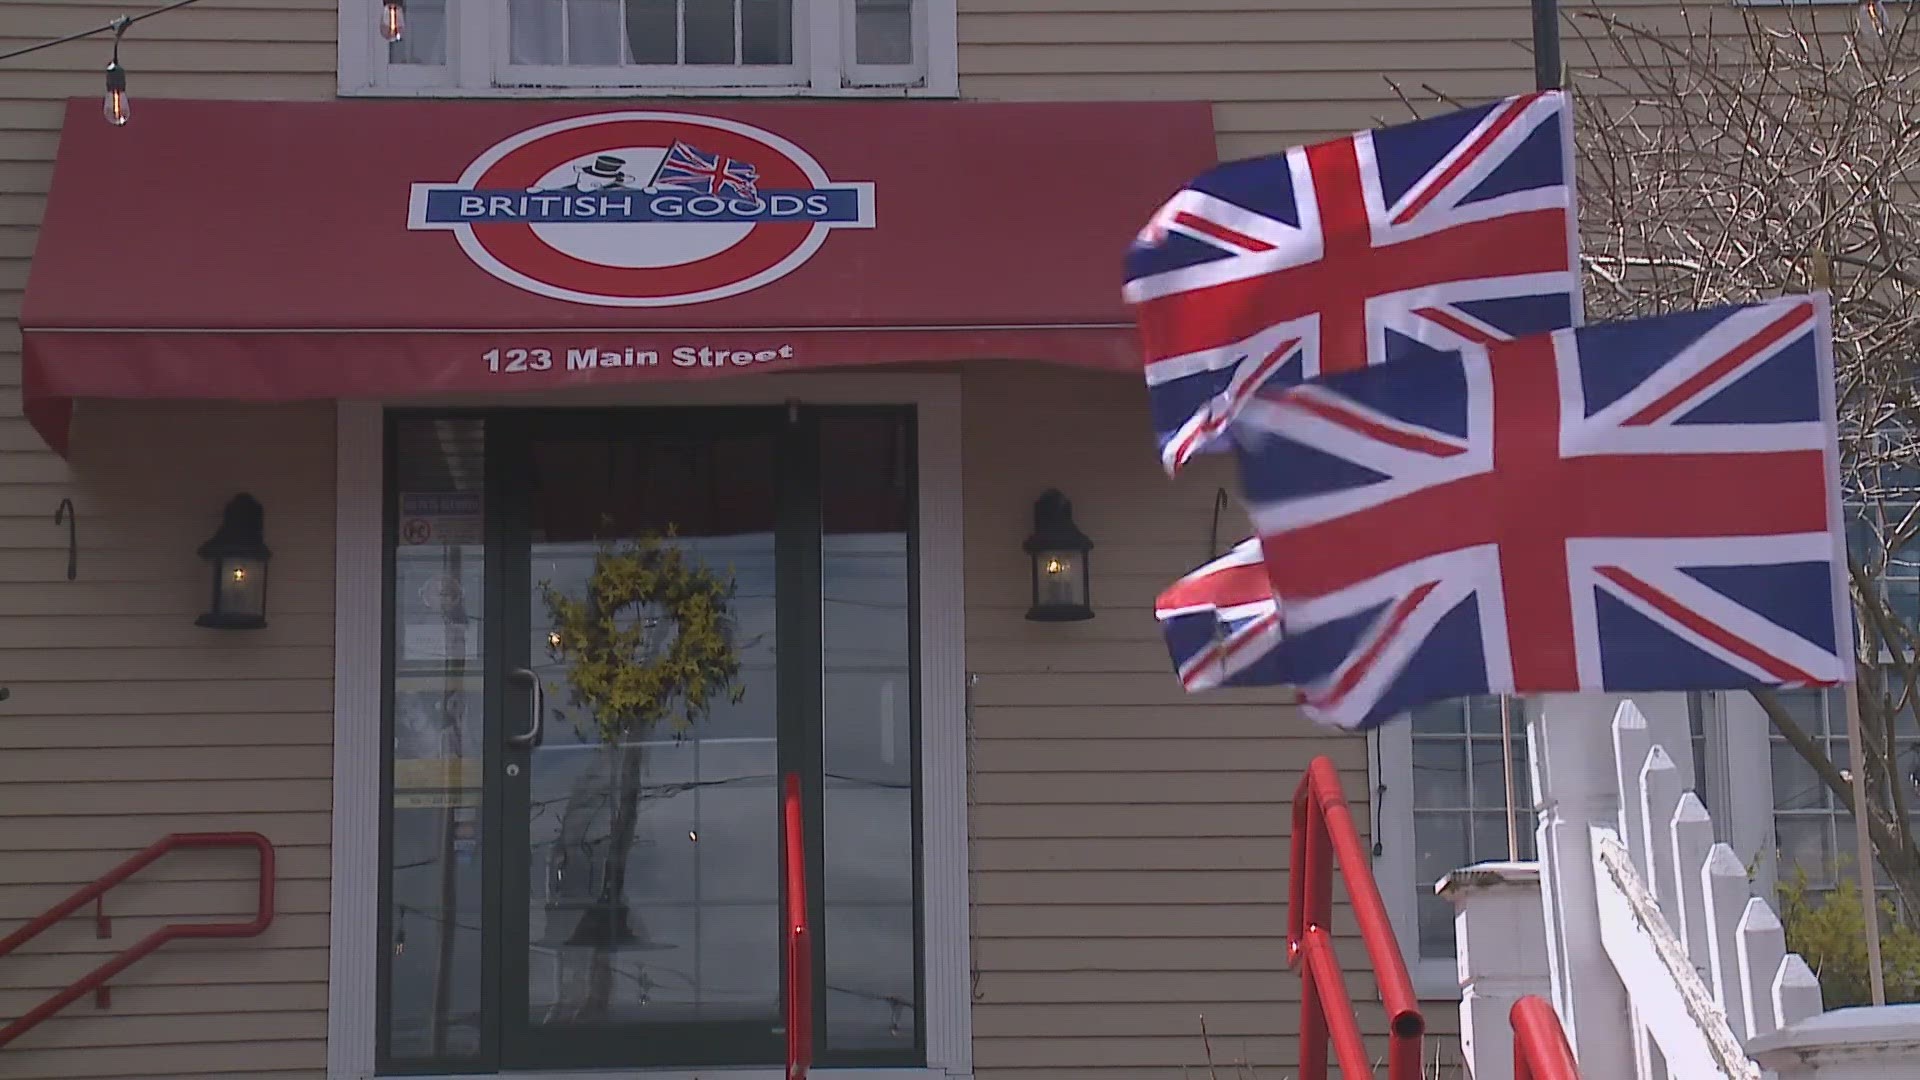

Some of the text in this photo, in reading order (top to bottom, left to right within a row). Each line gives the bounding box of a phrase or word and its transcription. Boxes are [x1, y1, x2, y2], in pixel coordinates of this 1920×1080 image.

[459, 195, 828, 217] BRITISH GOODS
[482, 344, 794, 373] 123 Main Street
